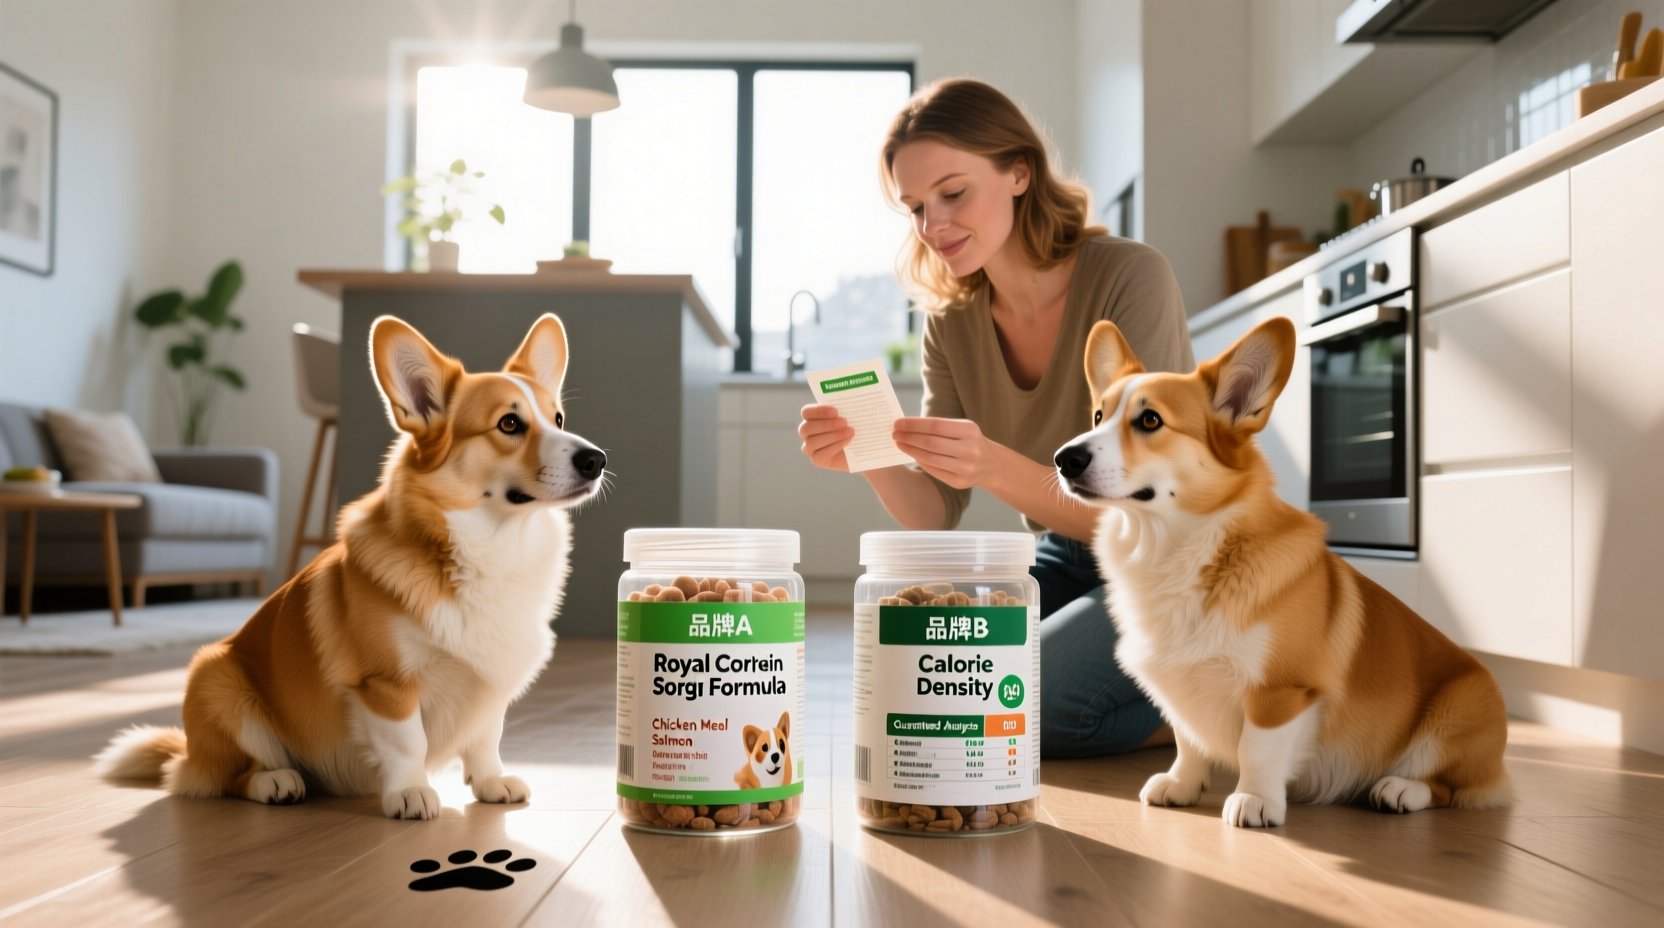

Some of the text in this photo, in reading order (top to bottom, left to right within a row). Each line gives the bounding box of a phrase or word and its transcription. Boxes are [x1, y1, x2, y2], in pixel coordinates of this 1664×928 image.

[689, 613, 753, 638] 品牌A
[925, 615, 989, 641] 品牌B
[654, 652, 710, 678] Royal
[918, 653, 994, 673] Calorie
[709, 675, 787, 696] Formula
[917, 676, 994, 701] Density
[652, 717, 697, 731] Chicken
[652, 734, 693, 747] Salmon
